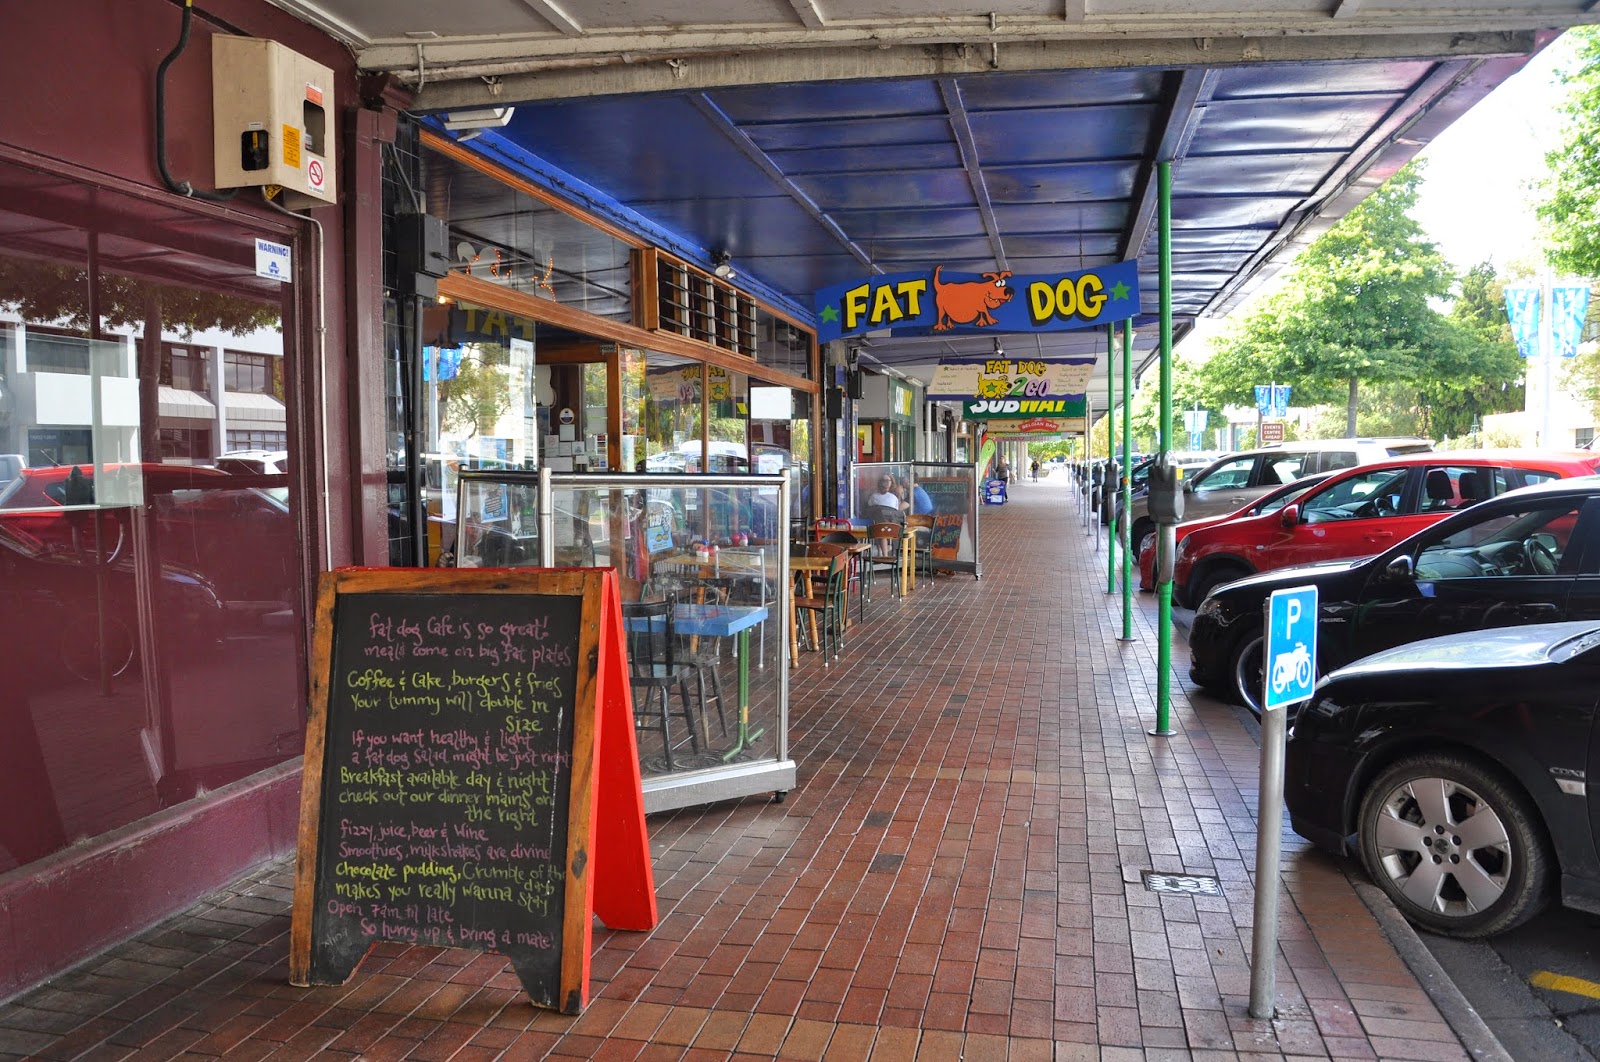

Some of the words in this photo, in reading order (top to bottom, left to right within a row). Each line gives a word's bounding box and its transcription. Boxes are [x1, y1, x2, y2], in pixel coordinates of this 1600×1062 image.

[257, 241, 289, 257] WARNING!
[844, 278, 927, 329] FAT
[1028, 274, 1109, 322] DOG
[985, 360, 1012, 374] FAT
[1017, 360, 1048, 377] DOG
[1009, 376, 1051, 397] 2GO
[970, 400, 1065, 414] SUBWAY
[1021, 421, 1044, 430] BELGIAN
[397, 619, 423, 645] dog
[458, 618, 472, 639] is
[500, 615, 550, 646] great!
[1286, 598, 1302, 640] P
[364, 641, 405, 661] meals
[413, 644, 448, 658] come
[455, 646, 474, 658] on
[479, 643, 500, 666] big
[501, 644, 526, 663] fat
[532, 643, 571, 672] plates
[347, 669, 395, 690] Coffee
[452, 669, 511, 698] burgers
[526, 672, 563, 698] fries
[351, 693, 381, 711] Your
[389, 691, 440, 716] tummy
[445, 691, 473, 713] will
[480, 692, 526, 713] double
[532, 694, 550, 713] in
[352, 729, 365, 746] If
[367, 735, 387, 750] you
[392, 728, 425, 748] want
[430, 729, 478, 751] healthy
[500, 729, 535, 754] light
[352, 751, 360, 764] a
[365, 749, 384, 767] fat
[386, 750, 410, 770] dog
[452, 748, 492, 769] might
[496, 748, 509, 762] be
[510, 750, 539, 770] just
[540, 750, 572, 773] right
[340, 766, 403, 789] Breakfast
[406, 769, 461, 790] available
[466, 771, 491, 794] day
[508, 770, 551, 796] night
[339, 789, 379, 805] check
[382, 790, 408, 806] out
[410, 793, 435, 803] our
[438, 789, 481, 804] dinner
[486, 790, 531, 810] mains
[536, 794, 553, 805] on
[464, 803, 493, 822] the
[499, 806, 539, 831] right
[411, 821, 437, 839] beer
[410, 842, 482, 861] milkshakes
[487, 845, 507, 861] are
[511, 842, 551, 860] divine
[462, 861, 525, 885] Crumble
[530, 864, 544, 881] of
[335, 882, 381, 901] makes
[388, 886, 411, 901] you
[418, 881, 456, 907] really
[462, 884, 513, 902] wanna
[327, 899, 363, 918] Open
[371, 904, 401, 919] 7am
[427, 904, 455, 923] late
[360, 918, 377, 936] So
[382, 921, 418, 942] hurry
[423, 927, 440, 943] up
[460, 925, 496, 947] bring
[502, 930, 511, 943] a
